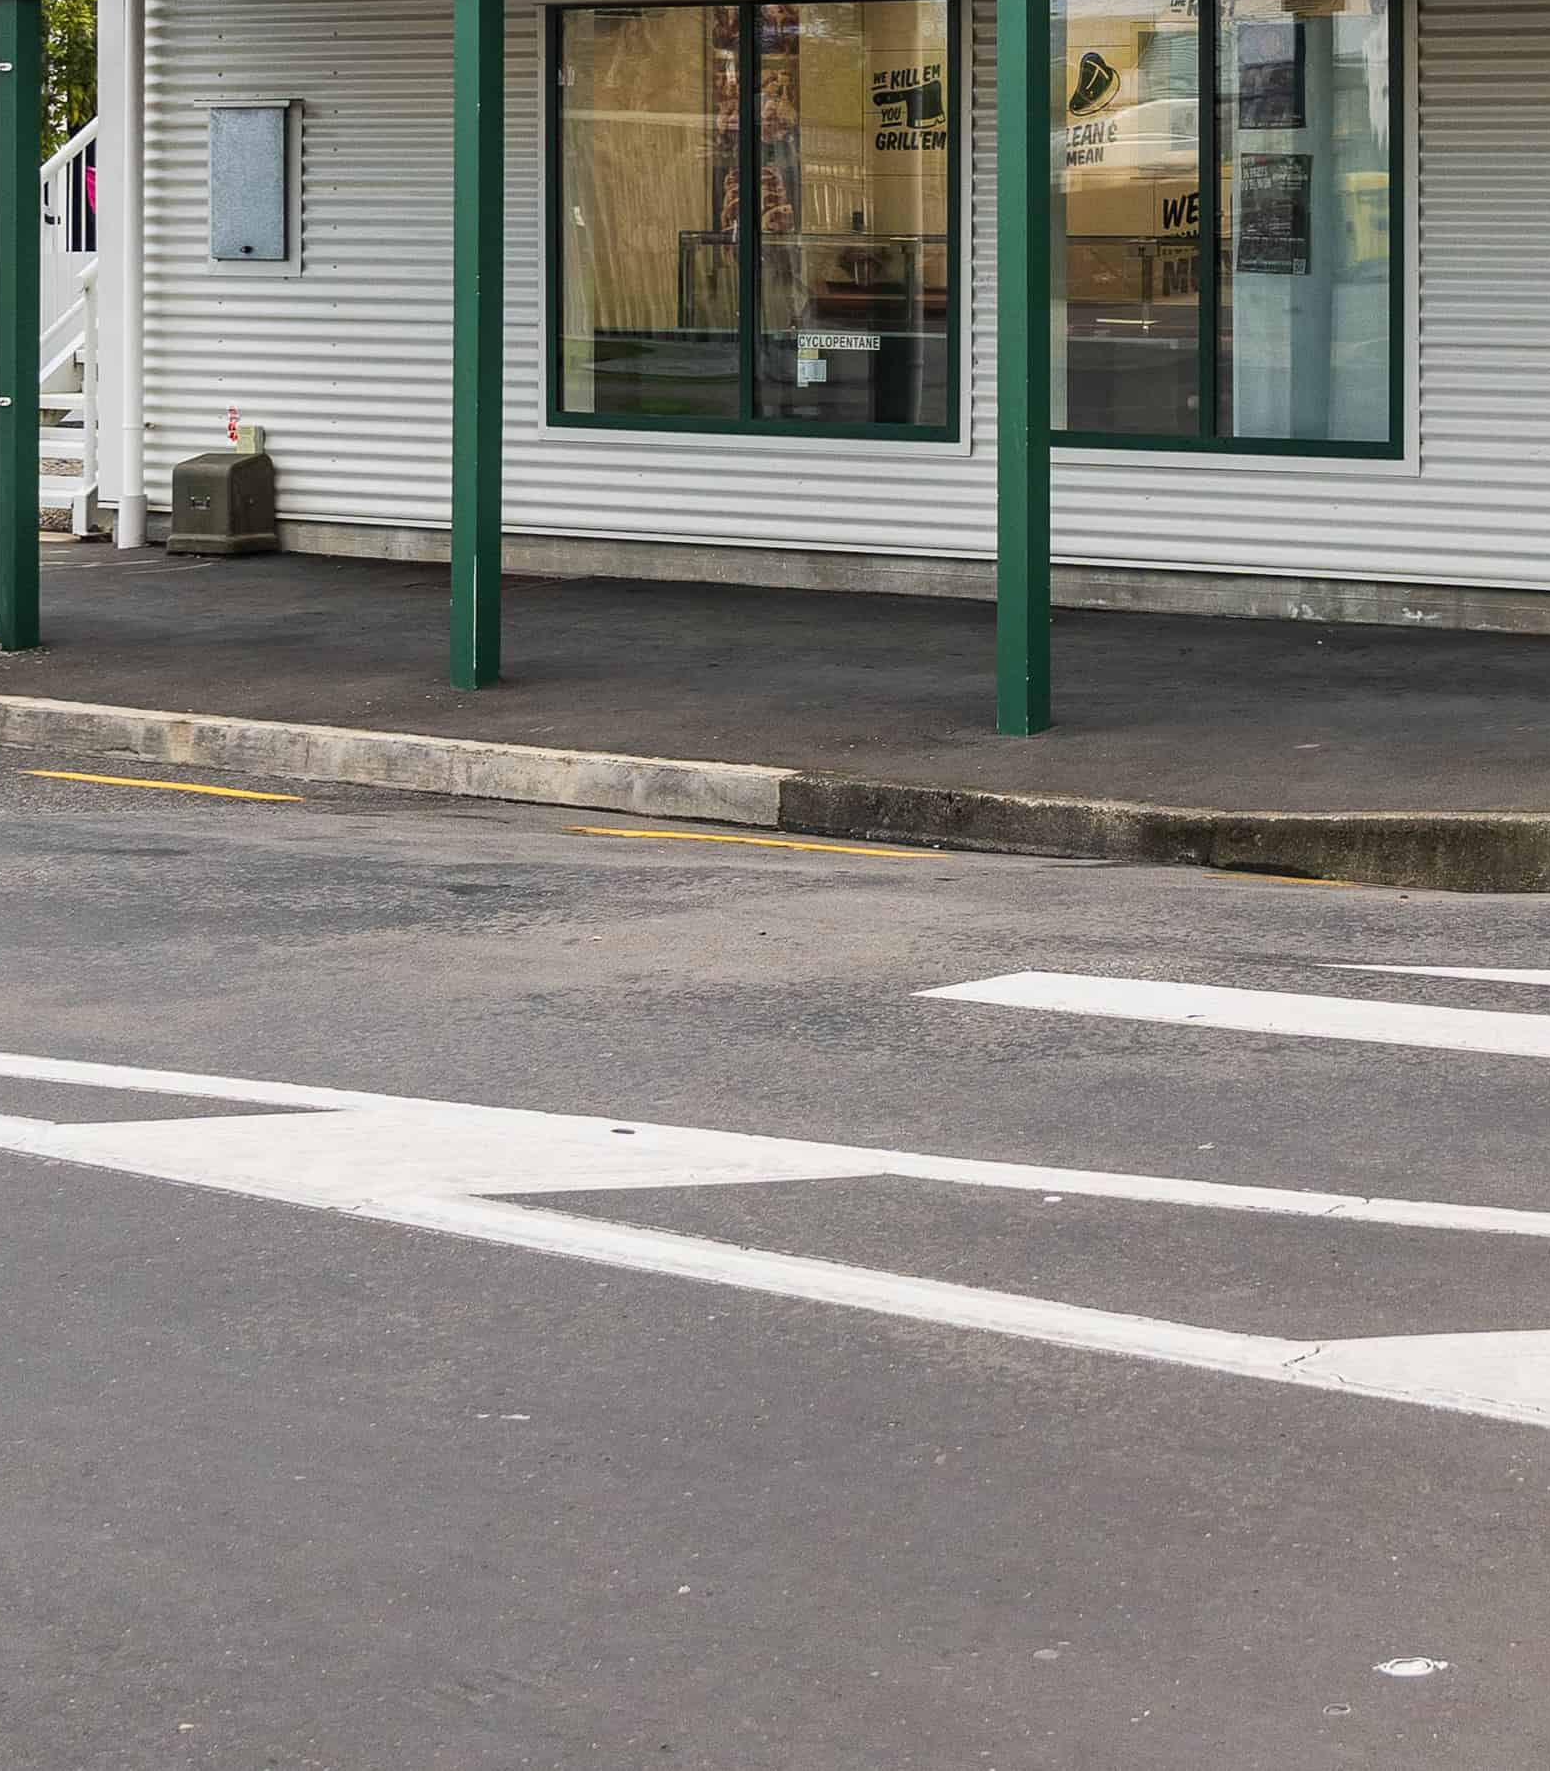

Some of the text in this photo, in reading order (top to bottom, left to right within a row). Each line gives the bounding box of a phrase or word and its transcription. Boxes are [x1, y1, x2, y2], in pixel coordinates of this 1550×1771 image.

[890, 69, 920, 89] KILL
[881, 108, 902, 122] YOU
[1066, 147, 1104, 167] MEAN
[798, 336, 879, 349] CYCLOPENTANE
